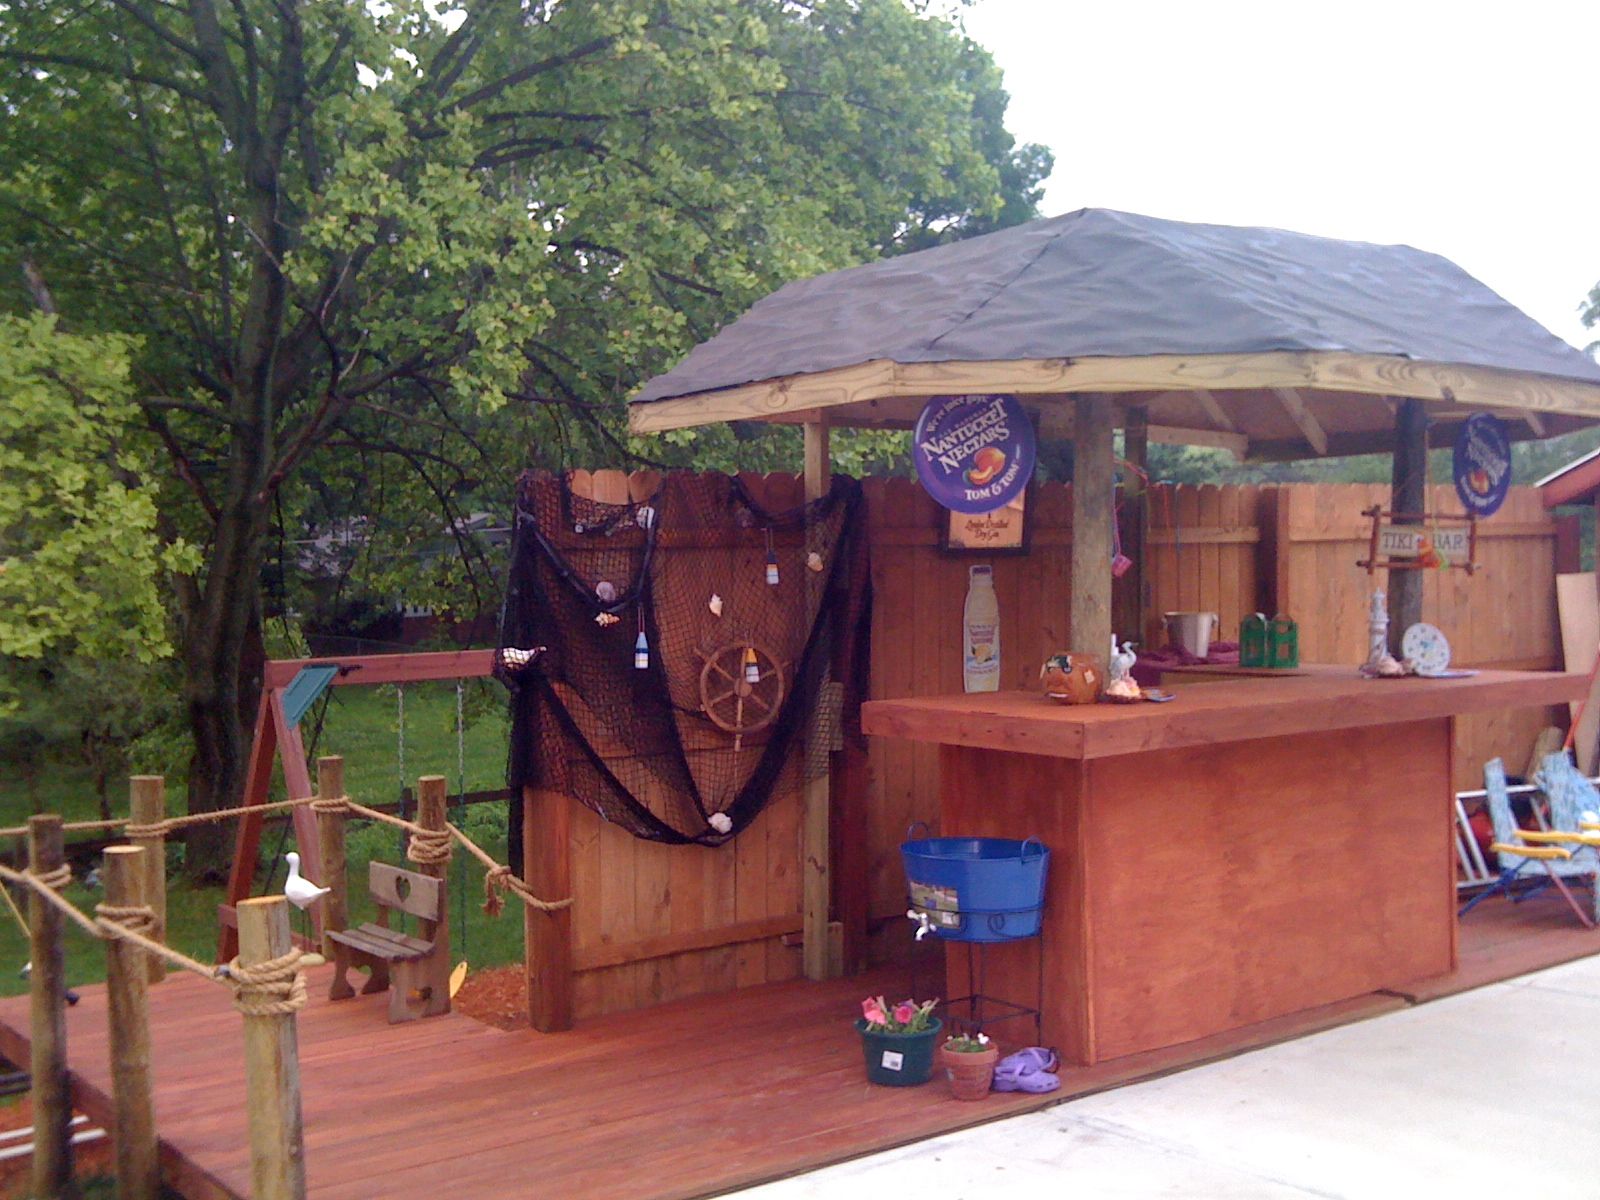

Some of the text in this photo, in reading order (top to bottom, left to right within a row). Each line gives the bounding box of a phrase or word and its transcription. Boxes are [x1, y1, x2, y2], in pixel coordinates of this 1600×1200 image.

[920, 398, 1008, 462] NANTUCKET
[938, 420, 1010, 474] NECTARS
[965, 463, 1020, 501] TOM & TOM
[1382, 532, 1413, 550] TIKI
